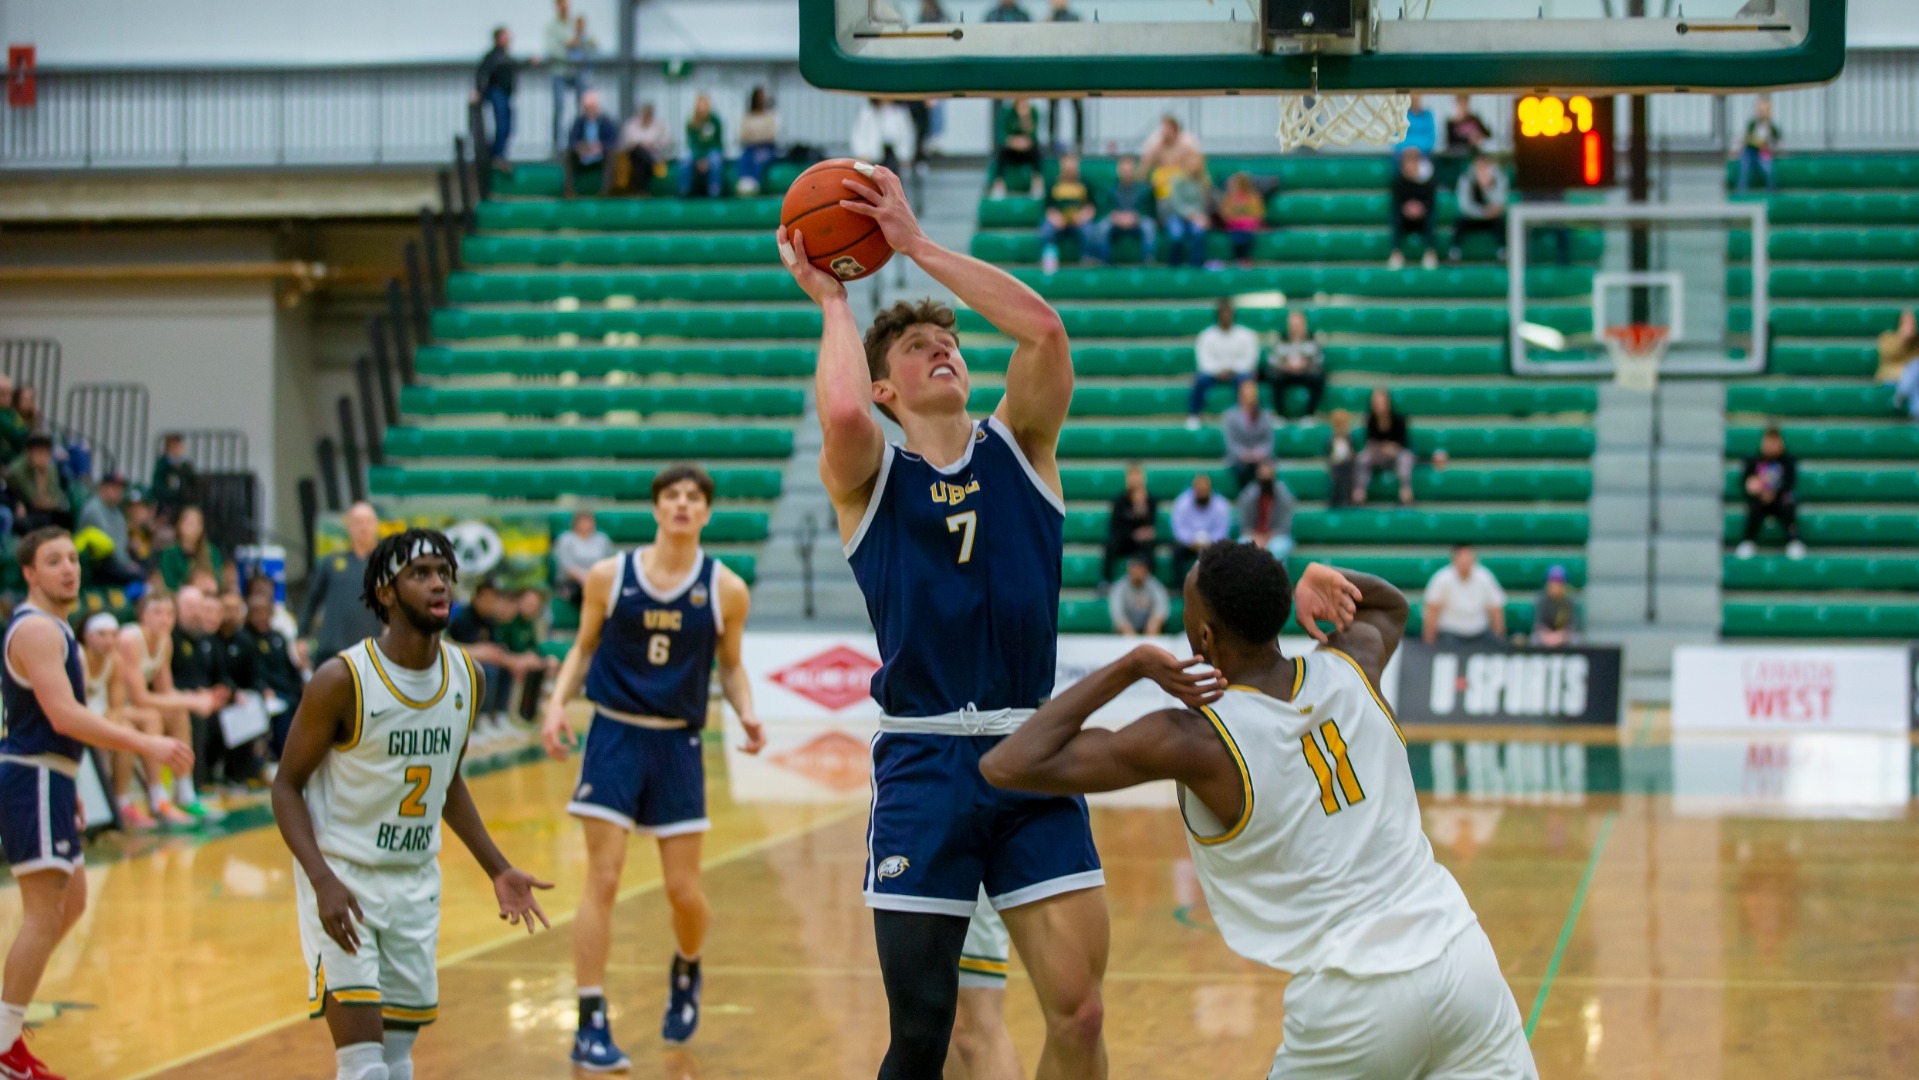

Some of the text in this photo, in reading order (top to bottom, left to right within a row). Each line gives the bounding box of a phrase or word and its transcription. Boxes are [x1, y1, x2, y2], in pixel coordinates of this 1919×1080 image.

[1583, 130, 1600, 185] 1
[946, 510, 977, 564] 7
[643, 609, 683, 631] UBC
[648, 633, 671, 666] 6
[1744, 684, 1834, 722] WEST
[388, 727, 452, 757] GOLDEN
[1300, 718, 1366, 816] 11
[398, 765, 432, 818] 2
[376, 822, 433, 852] BEARS
